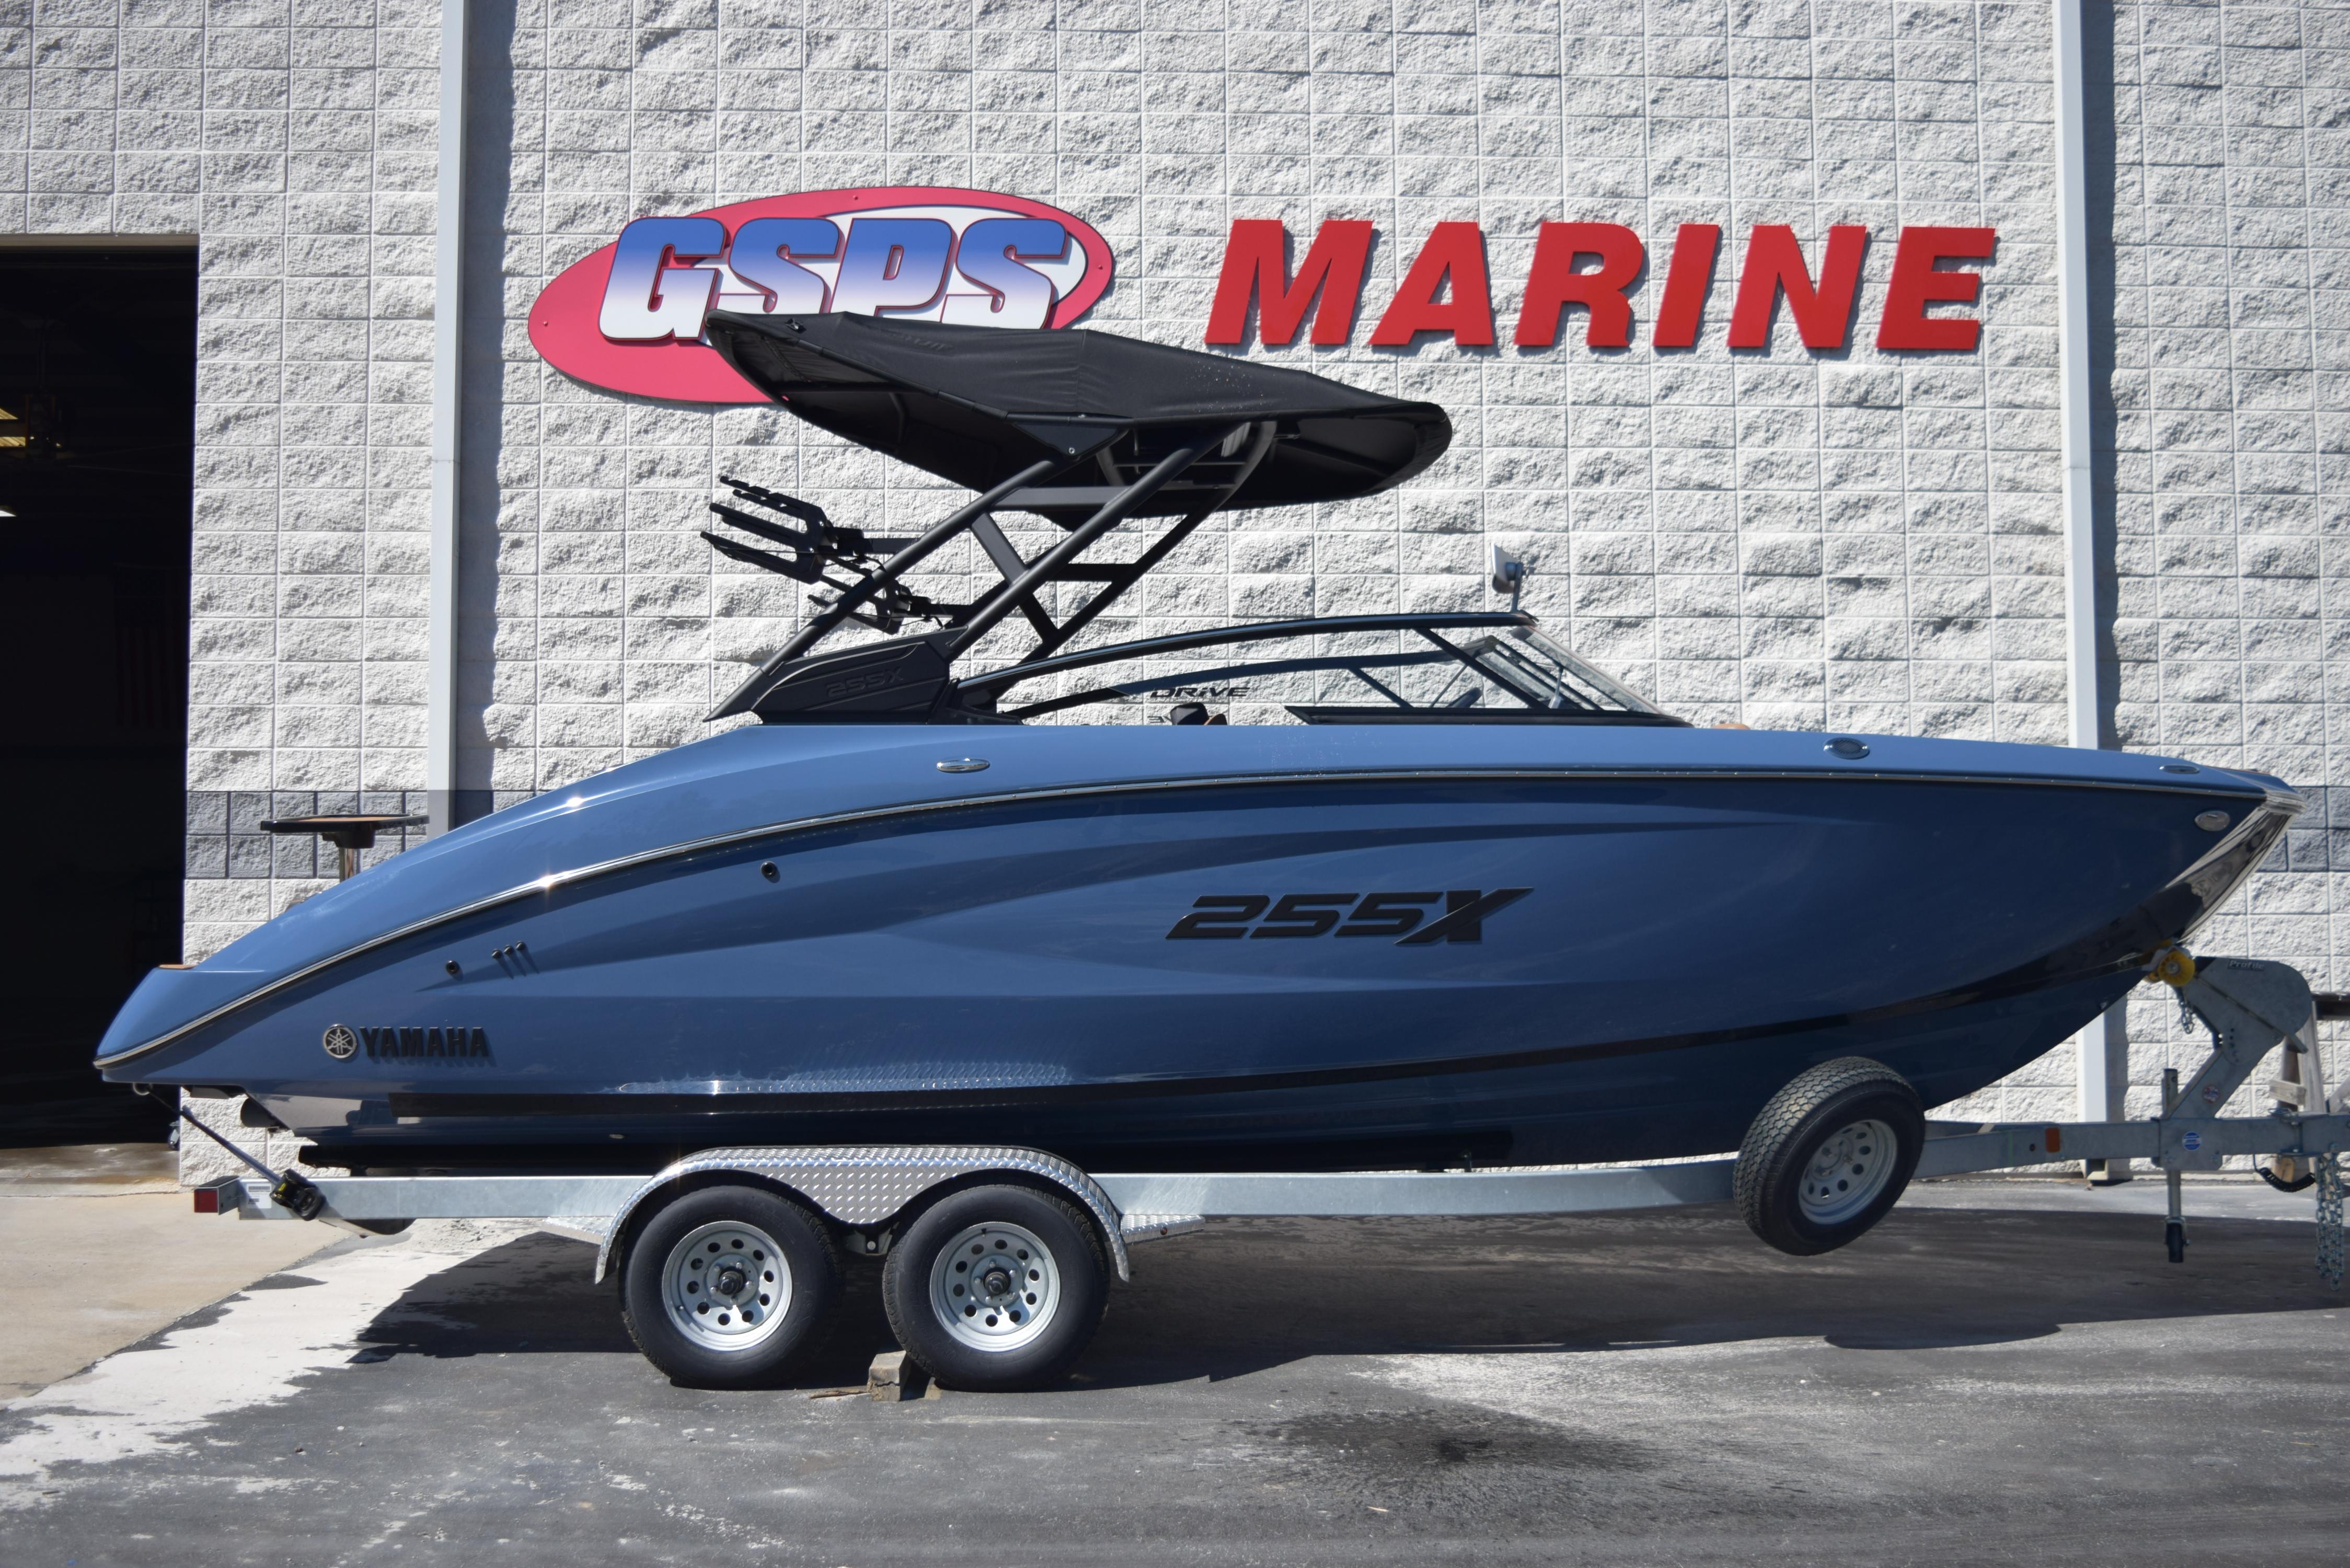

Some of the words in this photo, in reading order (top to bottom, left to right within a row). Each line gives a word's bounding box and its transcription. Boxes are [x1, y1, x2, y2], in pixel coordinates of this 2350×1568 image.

[598, 217, 1068, 340] GSPS
[1204, 218, 1996, 351] MARINE
[825, 666, 904, 697] 255X
[1165, 887, 1534, 945] 255X
[2229, 960, 2265, 971] Profile
[360, 1026, 489, 1057] YAMAHA
